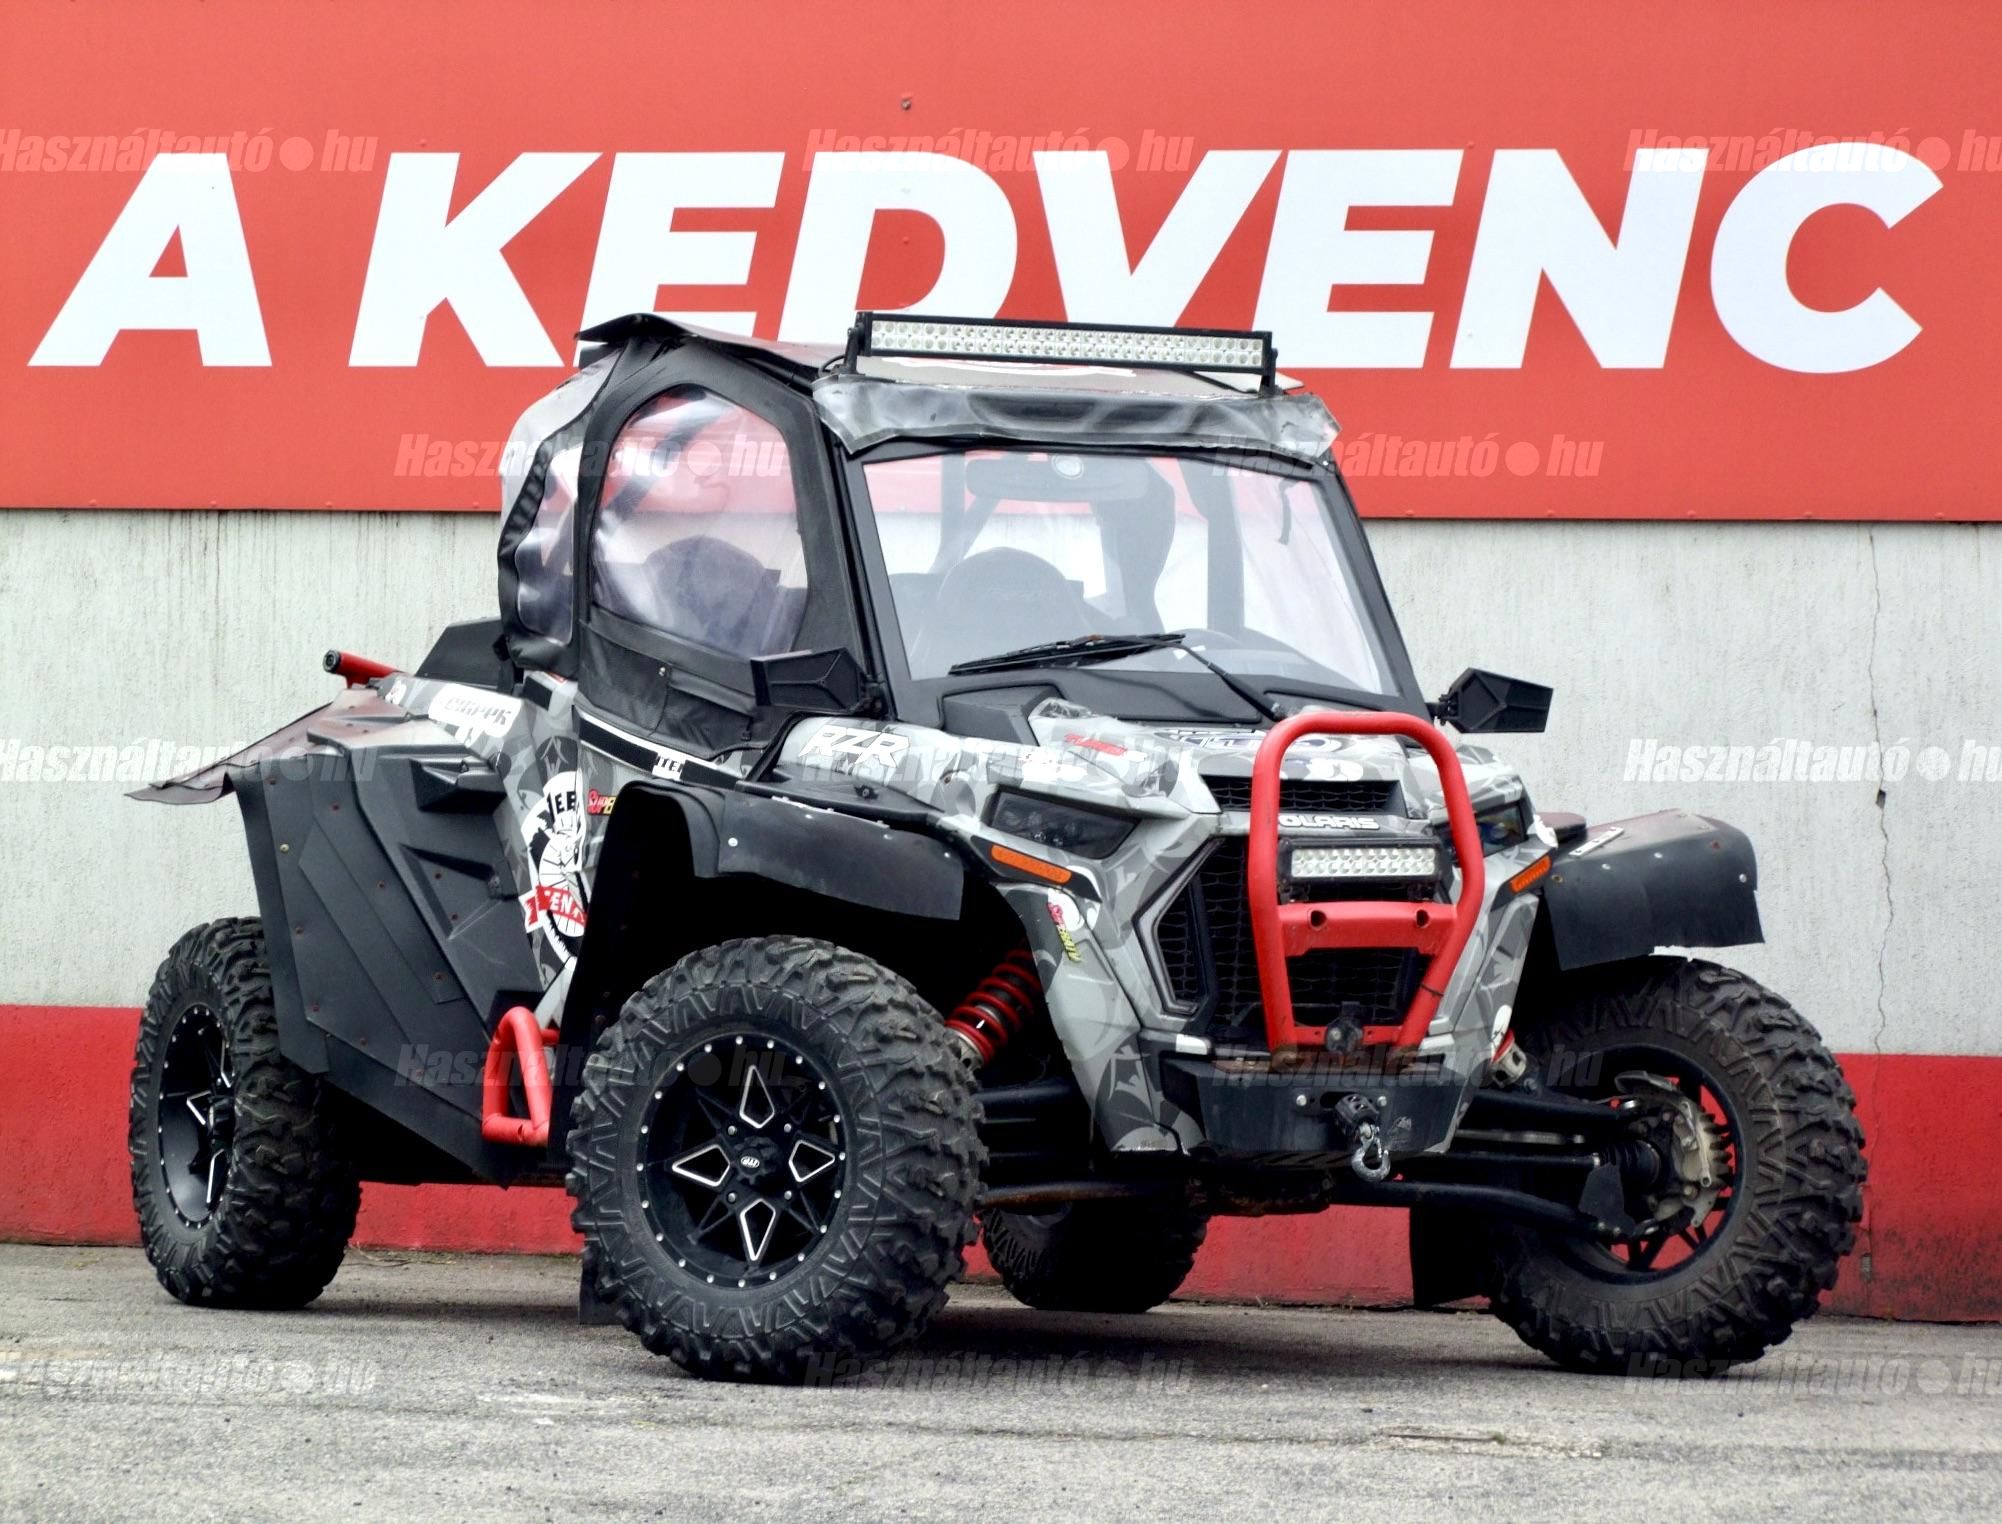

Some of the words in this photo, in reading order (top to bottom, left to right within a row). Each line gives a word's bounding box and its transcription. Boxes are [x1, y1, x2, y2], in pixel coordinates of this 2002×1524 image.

[27, 152, 272, 366] A
[348, 141, 1943, 374] KEDVENC
[1278, 814, 1380, 830] OLARIS
